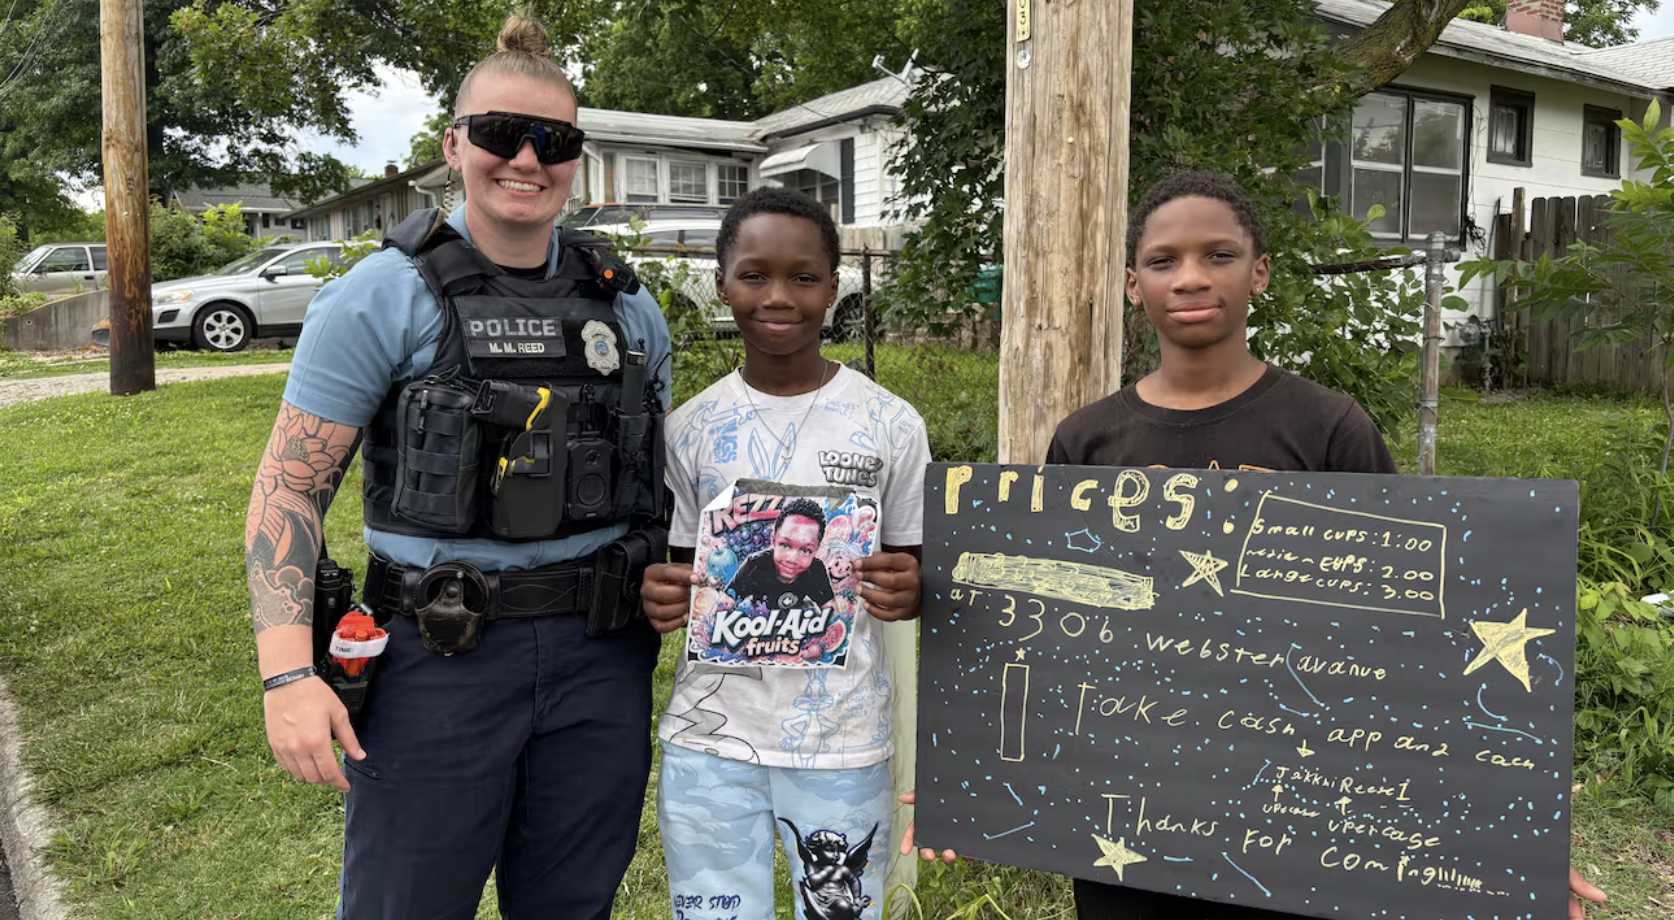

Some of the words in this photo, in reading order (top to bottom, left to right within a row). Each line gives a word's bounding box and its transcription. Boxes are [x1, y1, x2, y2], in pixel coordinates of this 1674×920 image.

[469, 319, 557, 337] POLICE
[489, 342, 502, 353] M.
[503, 342, 516, 353] M.
[518, 343, 545, 353] REED
[1381, 584, 1434, 601] 3.00
[711, 607, 828, 648] Kool-Aid
[746, 637, 800, 657] fruits
[1101, 793, 1219, 836] Thanks
